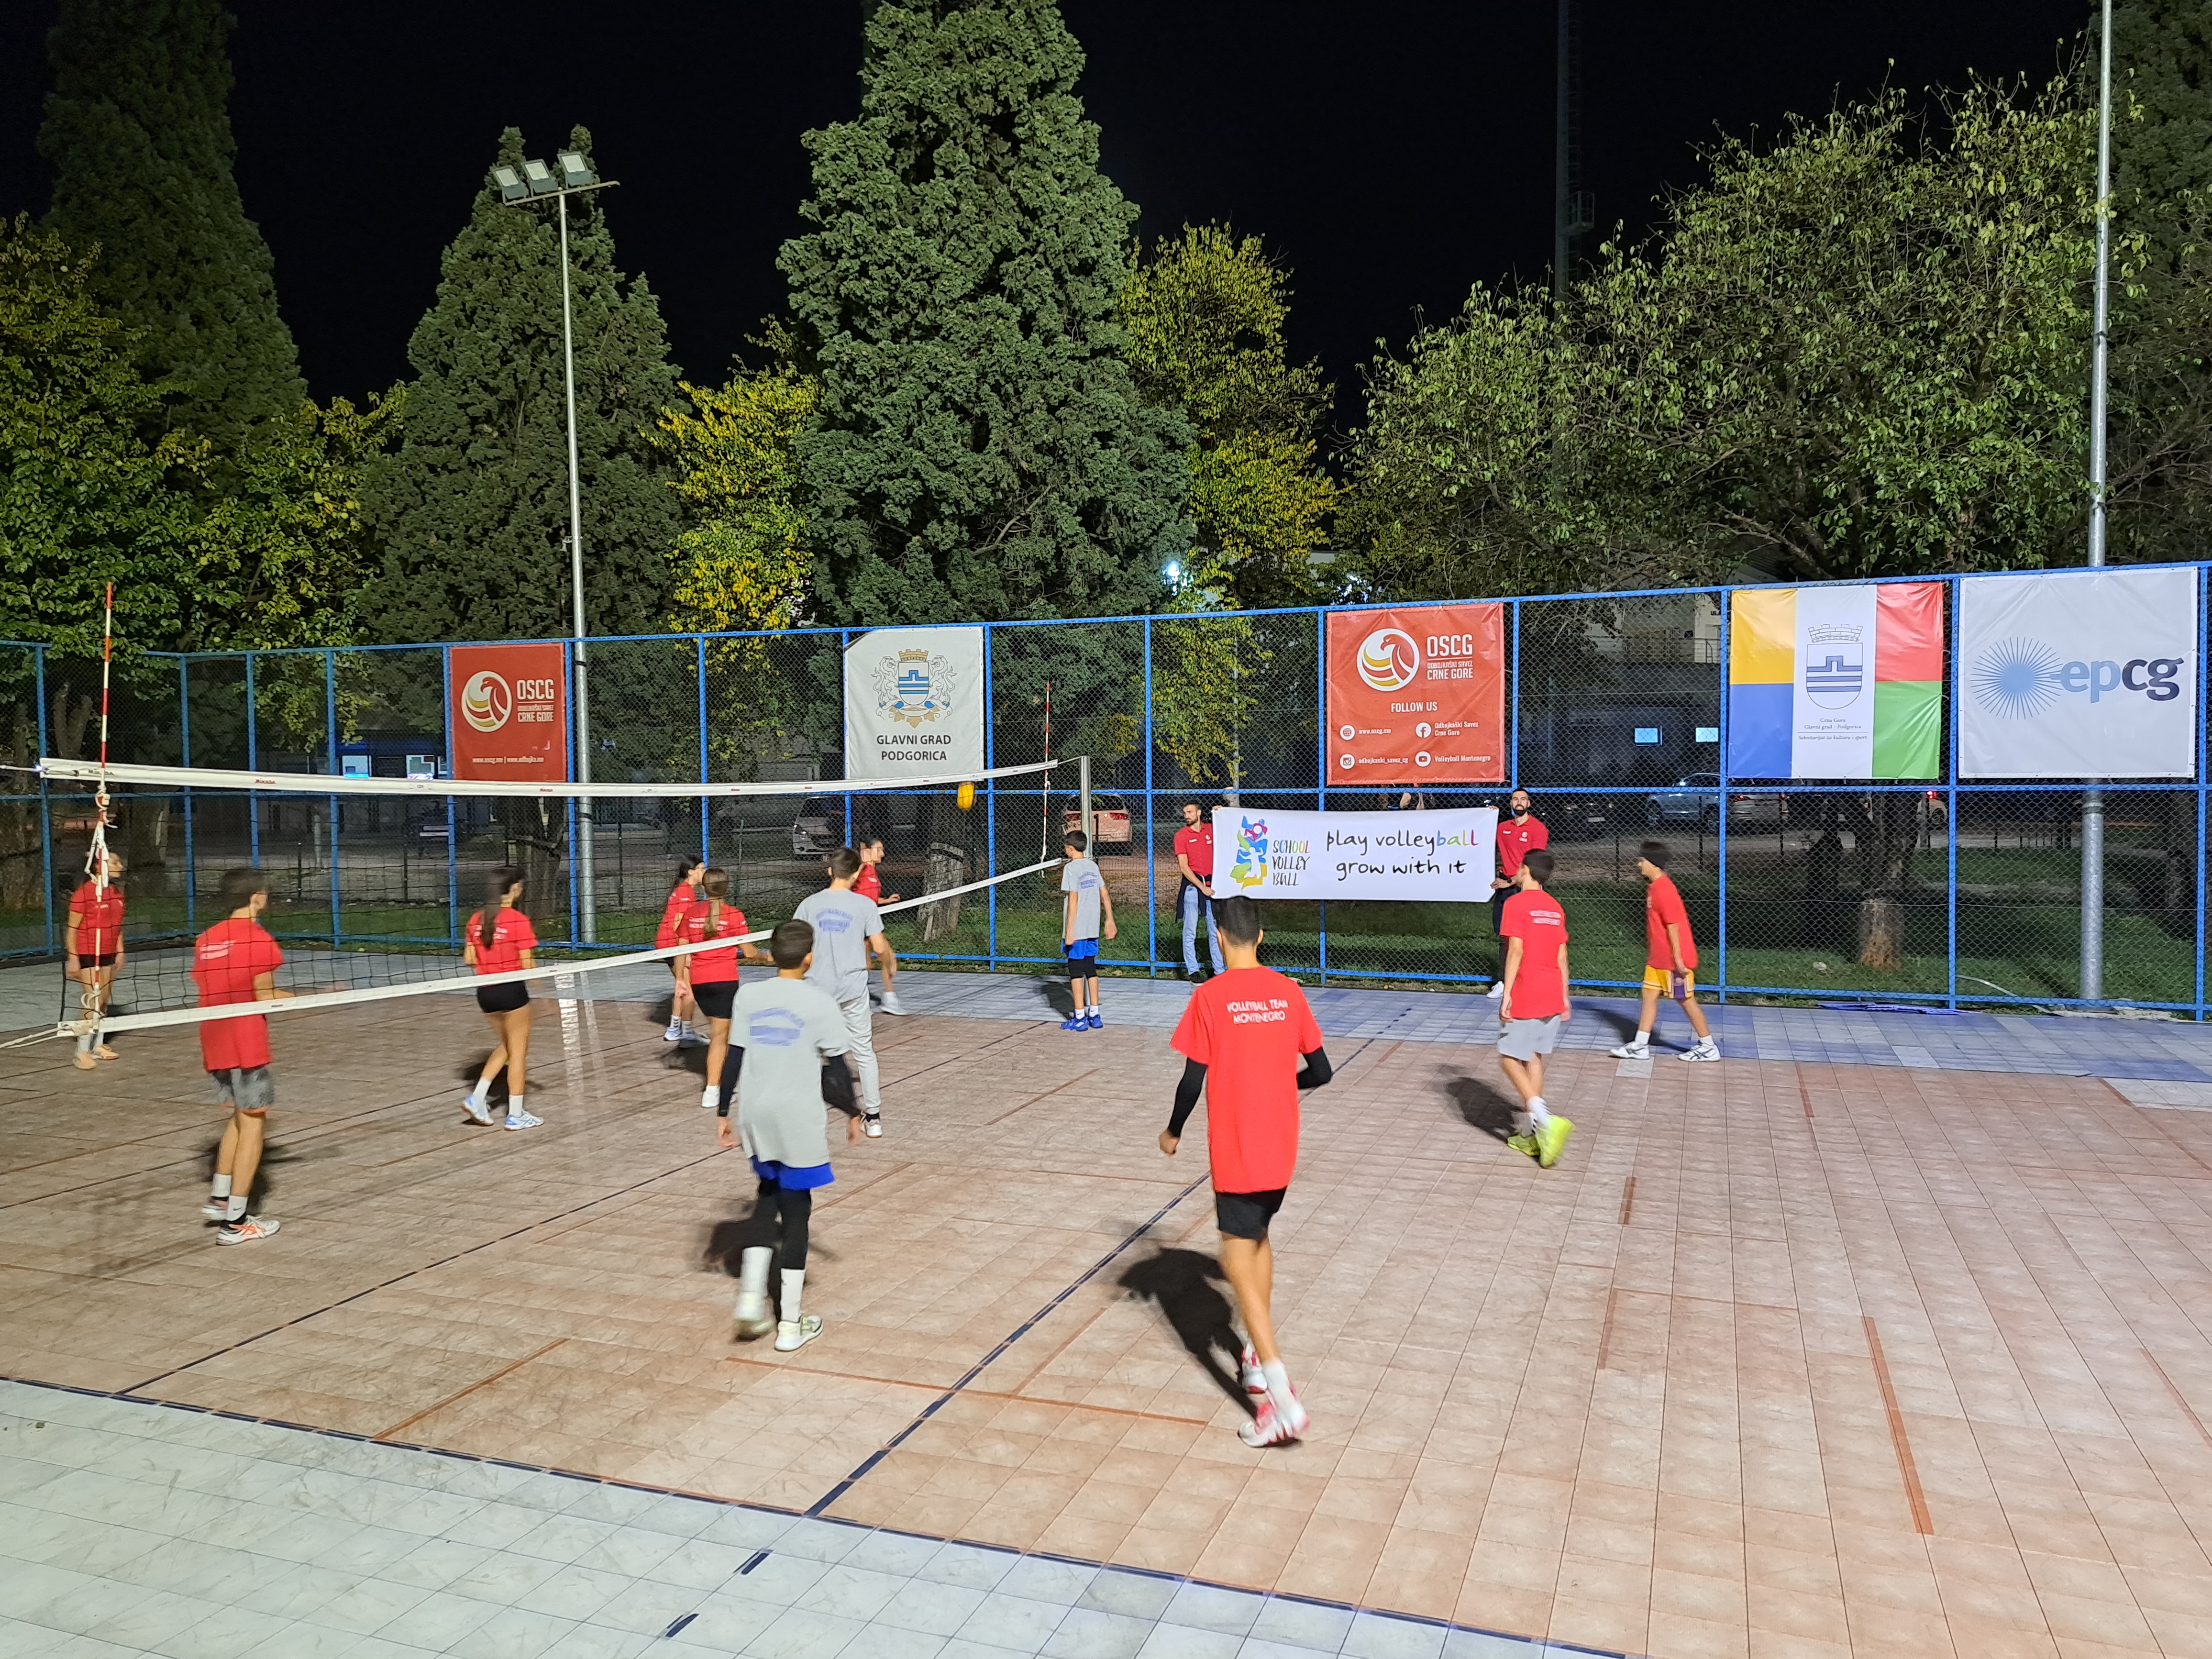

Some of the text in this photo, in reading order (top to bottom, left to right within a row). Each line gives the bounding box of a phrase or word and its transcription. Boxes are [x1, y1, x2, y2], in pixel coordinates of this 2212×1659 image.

[1427, 634, 1473, 657] OSCG
[1427, 661, 1457, 669] ODBOJKAŠKI
[1427, 668, 1473, 680] CRNE GORE
[2051, 657, 2185, 704] epcg
[517, 679, 554, 700] OSCG
[1391, 701, 1438, 713] FOLLOW US
[518, 711, 554, 722] CRNE GORE
[877, 735, 951, 744] GLAVNI GRAD
[881, 751, 947, 761] PODGORICA
[1272, 840, 1311, 854] SCHOOL
[1327, 829, 1479, 856] play volleyball
[1272, 856, 1311, 870] VOLLEY
[1337, 856, 1468, 881] grow with it
[1226, 998, 1289, 1013] VOLLEYBALL TEAM
[1233, 1010, 1286, 1025] MONTENEGRO
